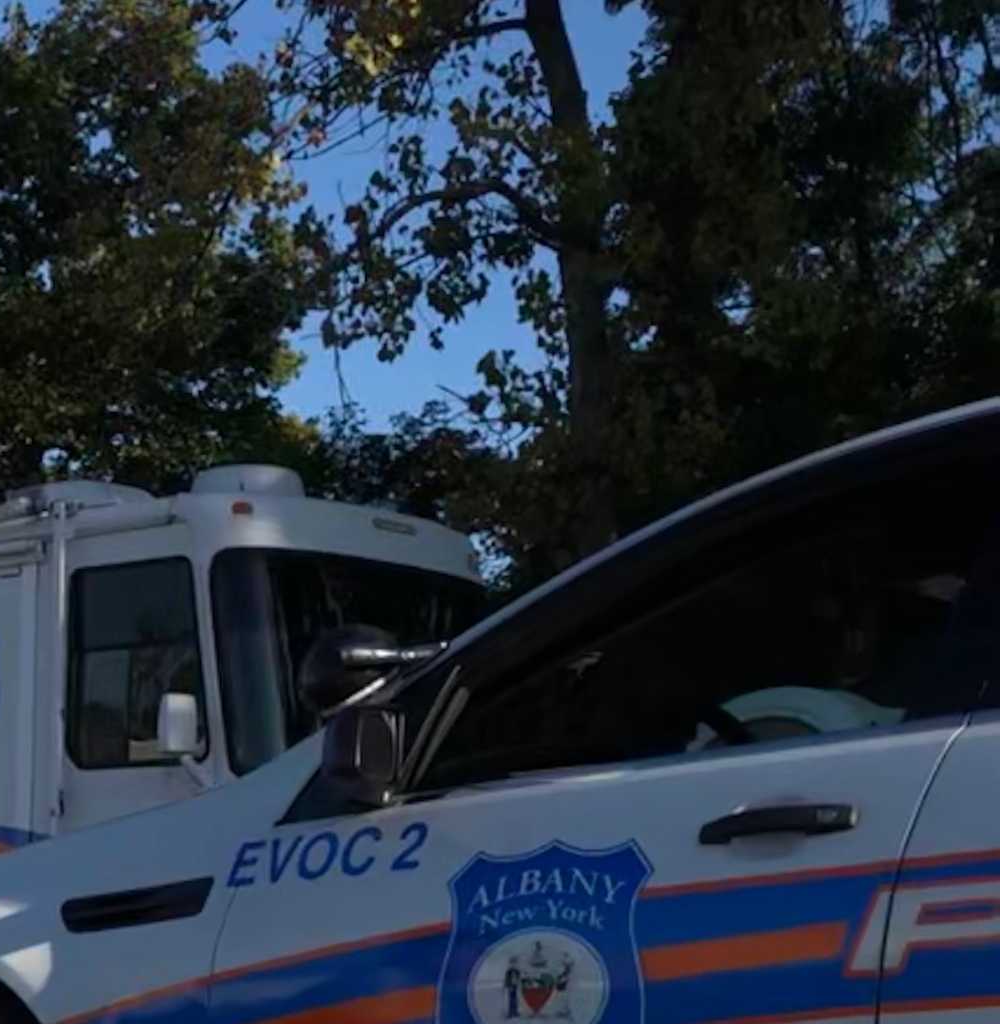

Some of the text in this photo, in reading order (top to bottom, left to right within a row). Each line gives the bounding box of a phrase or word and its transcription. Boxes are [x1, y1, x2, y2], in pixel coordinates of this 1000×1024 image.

[226, 821, 429, 887] EVOC 2
[467, 868, 626, 914] ALBANY
[479, 898, 605, 935] New York
